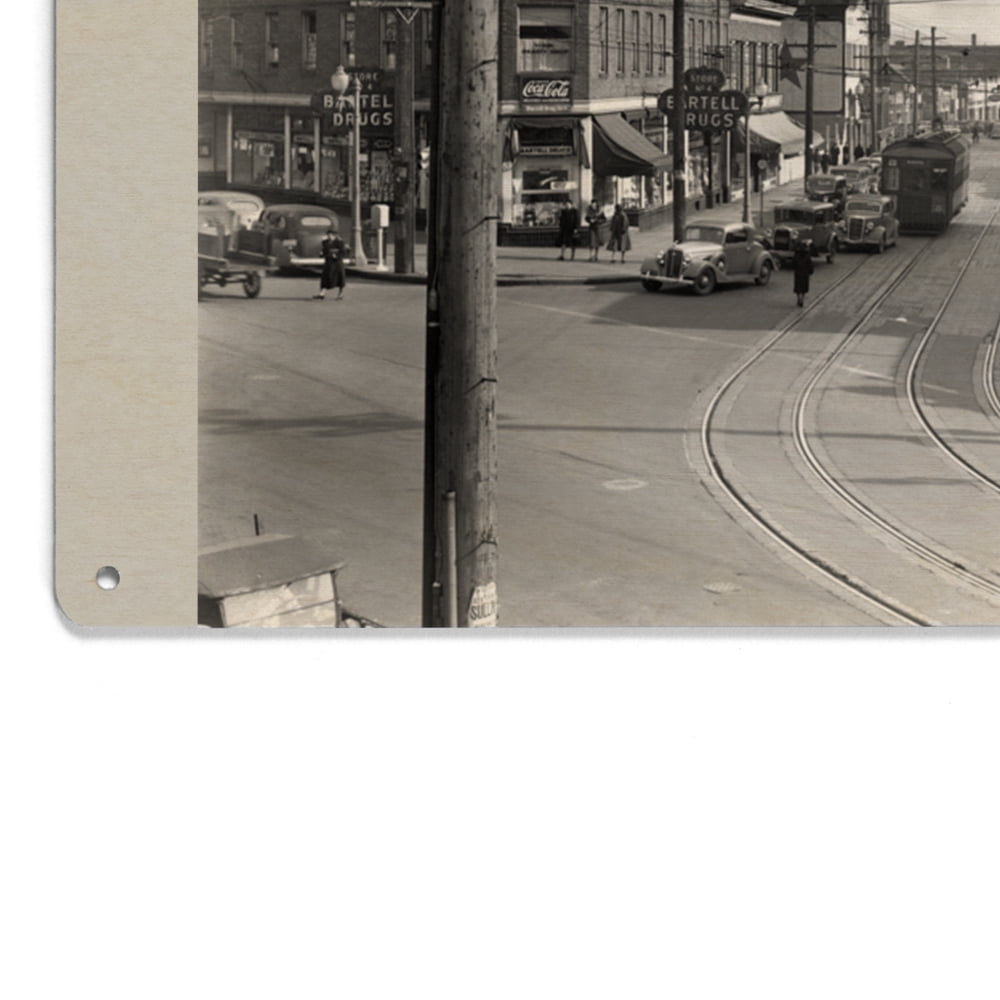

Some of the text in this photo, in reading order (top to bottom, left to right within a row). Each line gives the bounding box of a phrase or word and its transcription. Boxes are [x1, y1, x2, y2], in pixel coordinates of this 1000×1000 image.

[666, 95, 740, 110] BRTELL
[333, 112, 393, 127] DRUGS
[686, 113, 734, 127] RUGS
